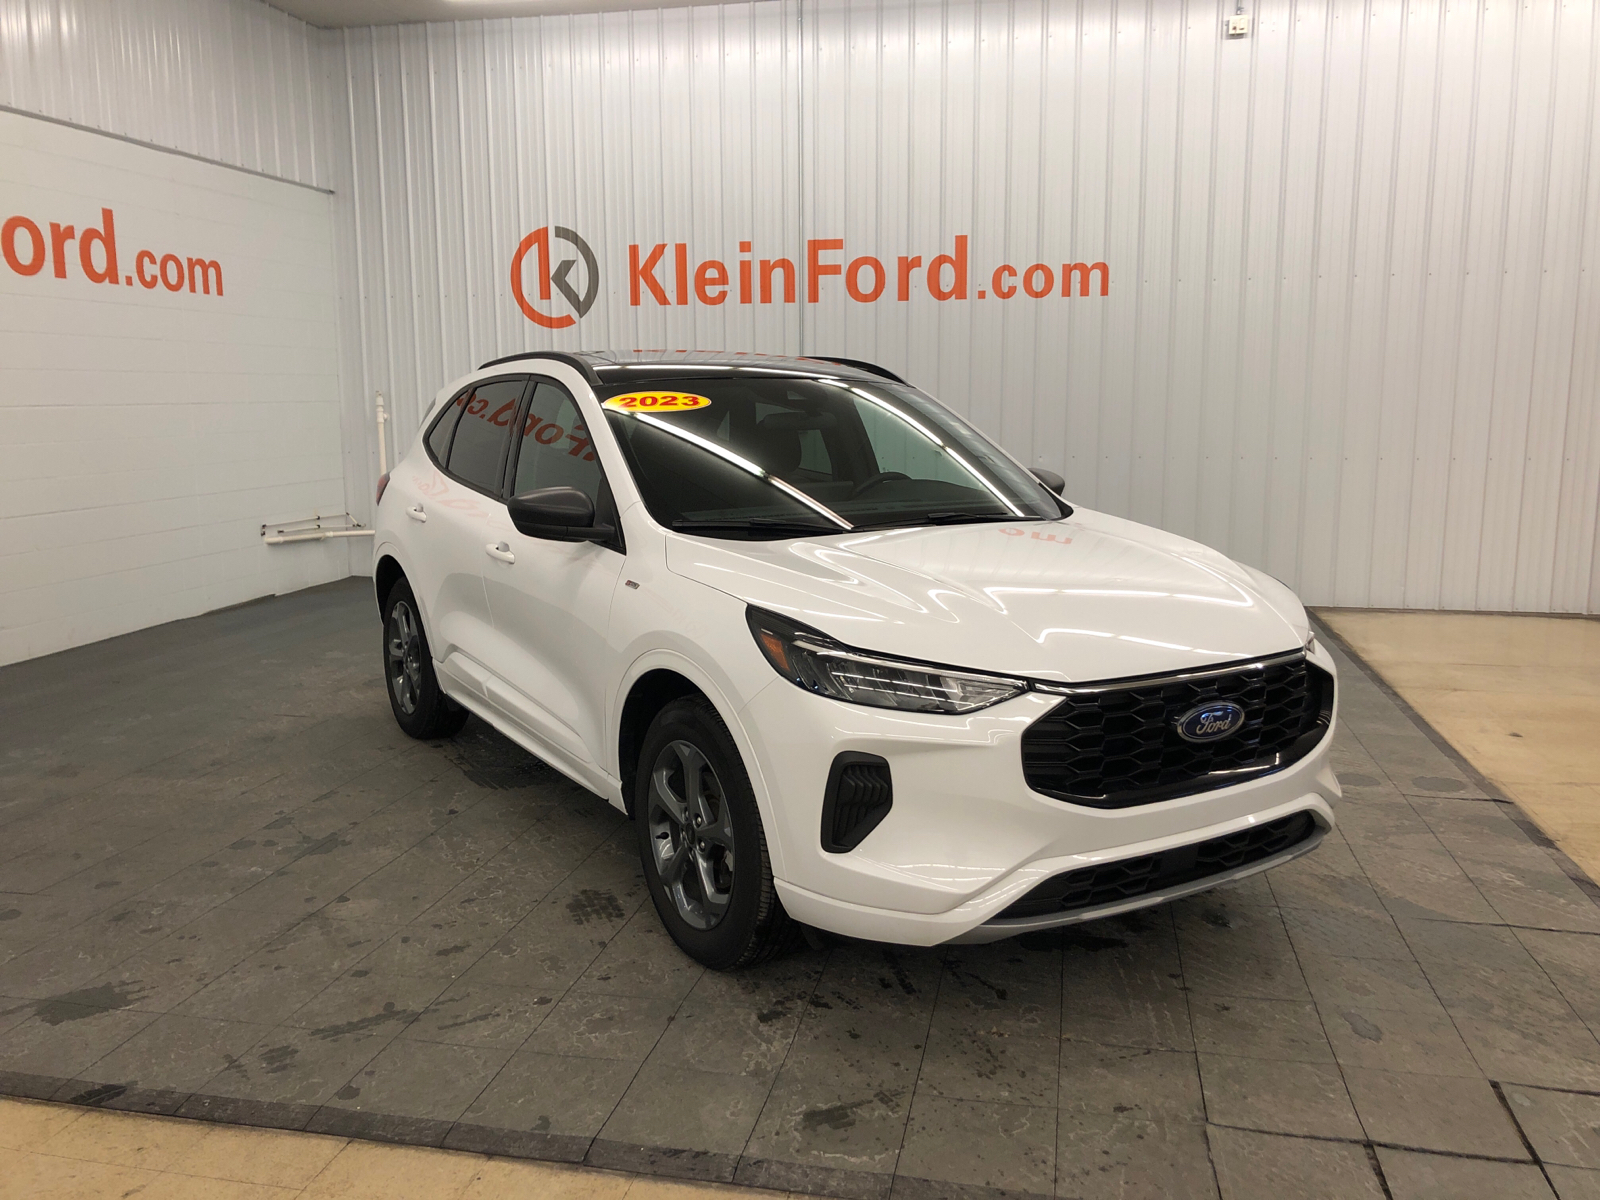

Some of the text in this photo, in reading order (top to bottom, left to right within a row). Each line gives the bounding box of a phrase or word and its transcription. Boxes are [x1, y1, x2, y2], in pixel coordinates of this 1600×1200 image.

[628, 235, 1110, 306] KleinFord.com
[618, 395, 700, 408] 2023
[1195, 711, 1232, 735] Ford
